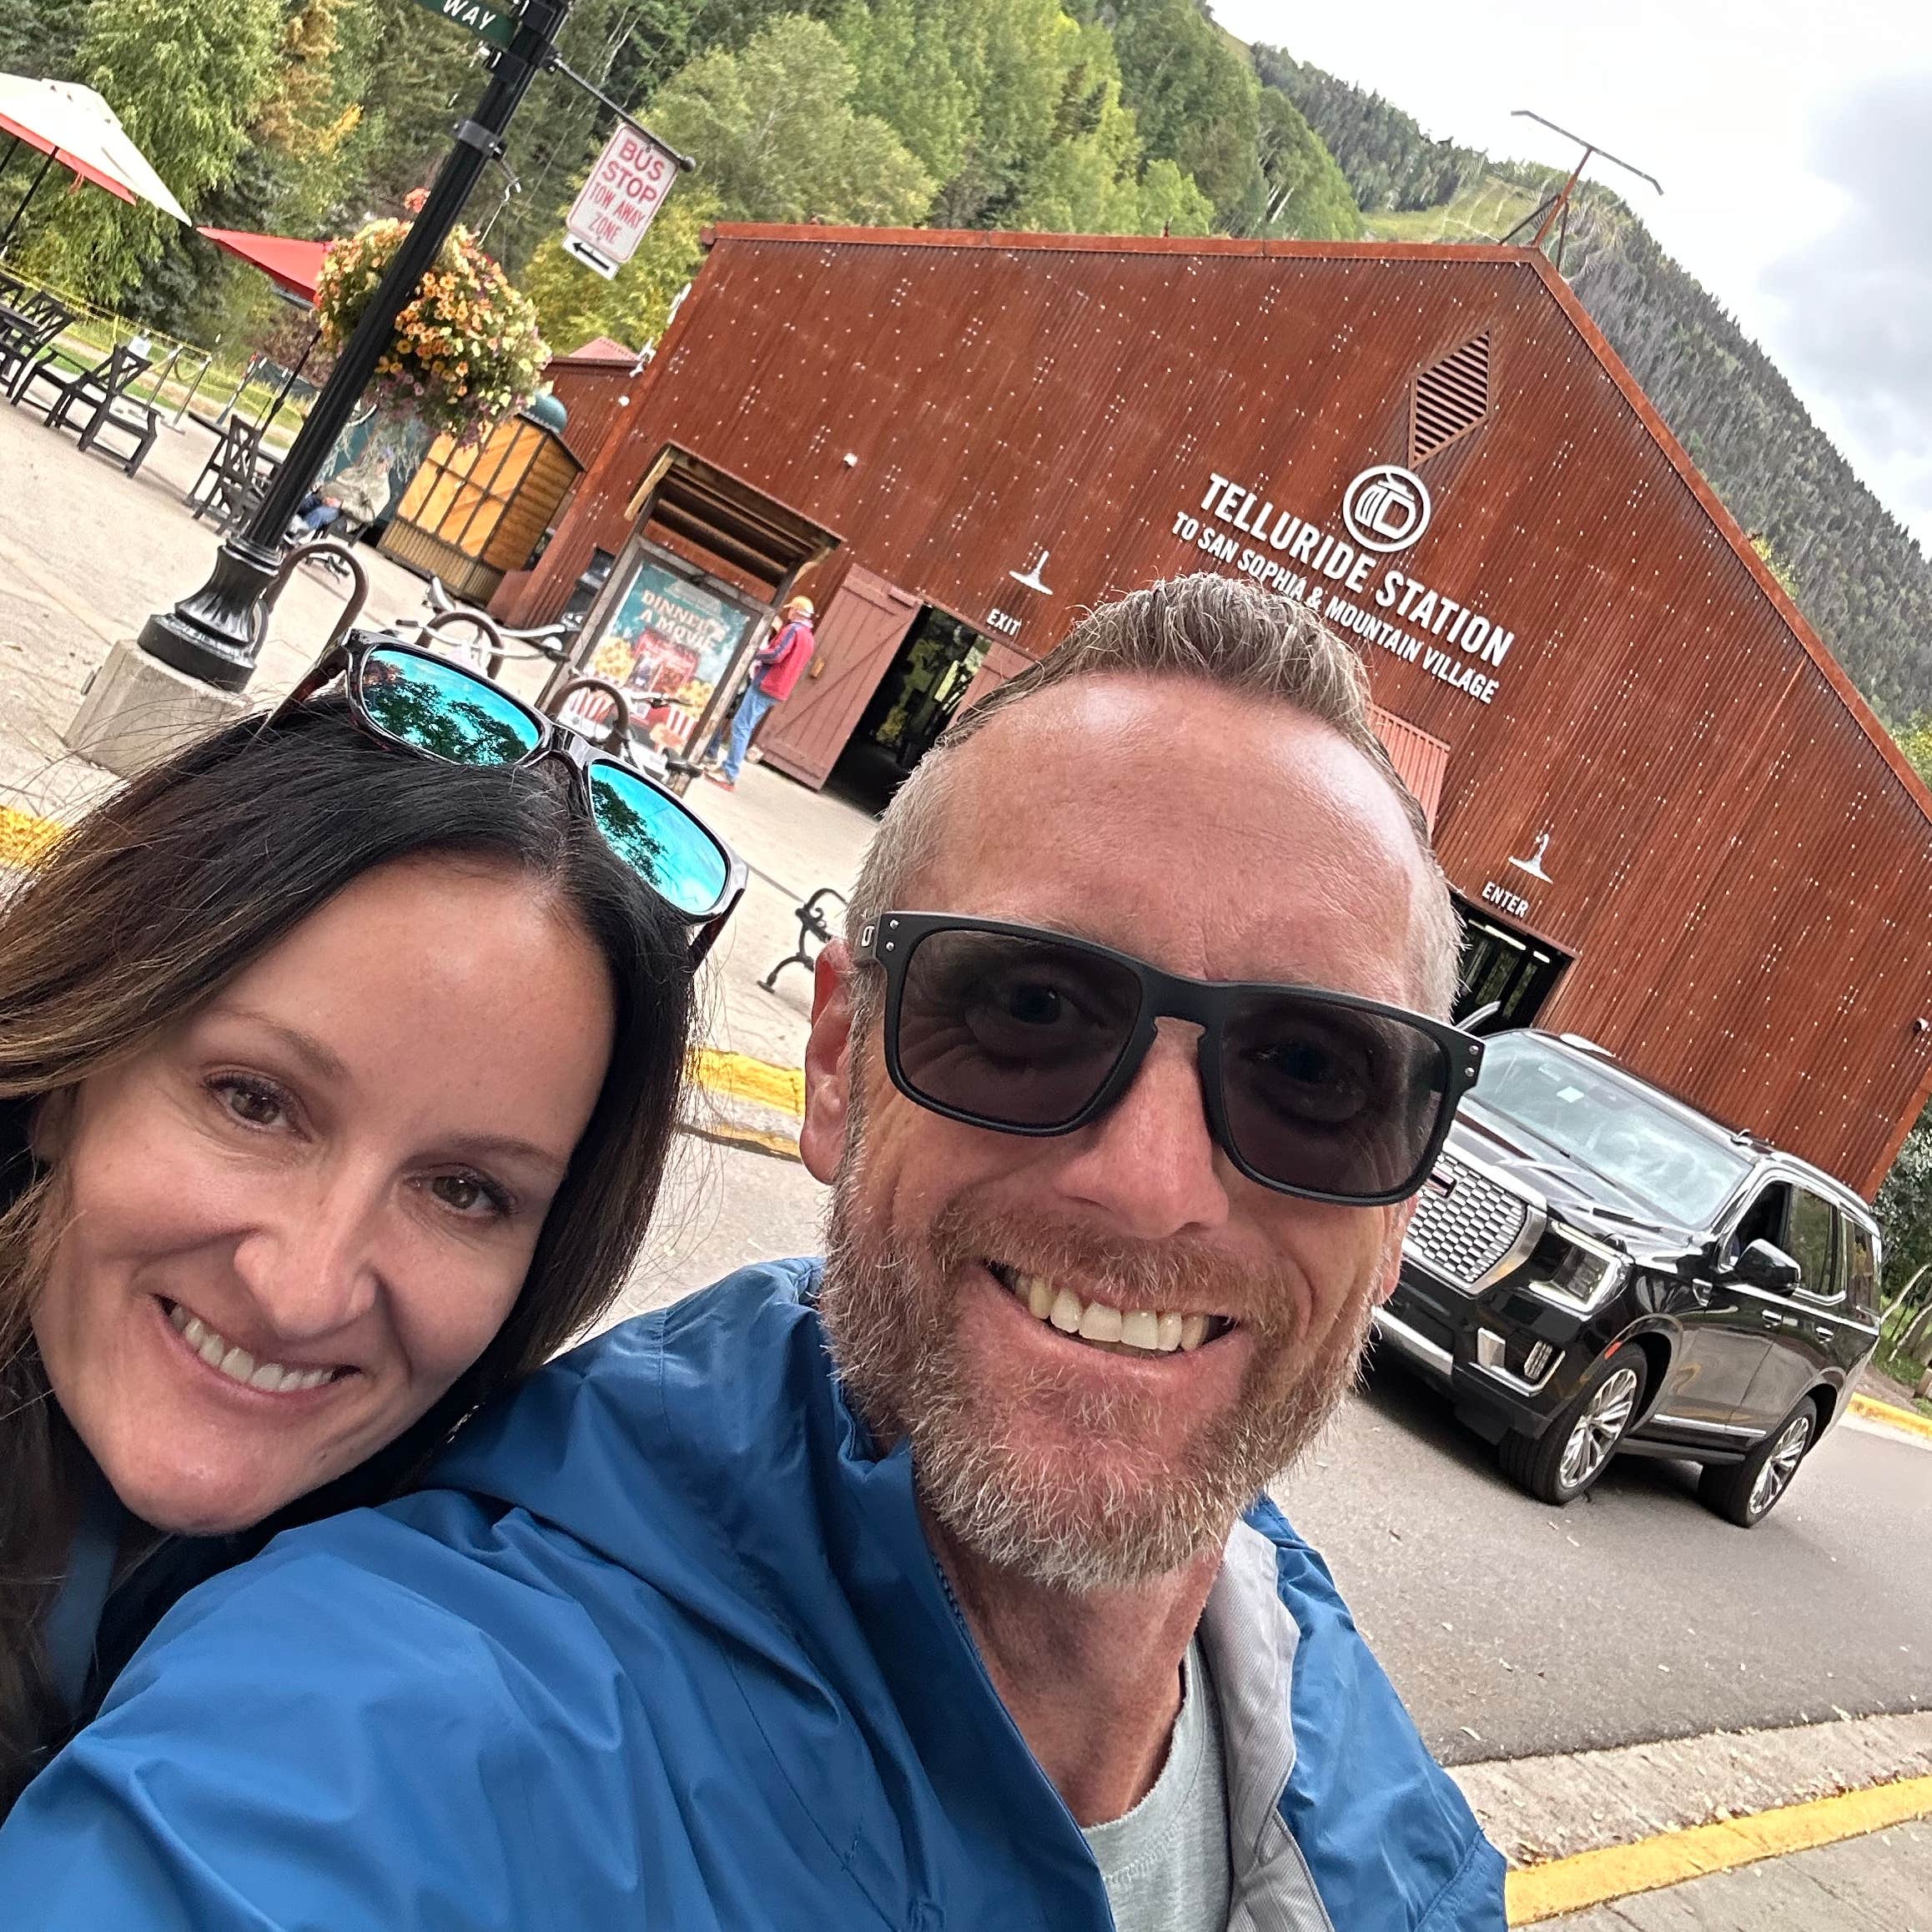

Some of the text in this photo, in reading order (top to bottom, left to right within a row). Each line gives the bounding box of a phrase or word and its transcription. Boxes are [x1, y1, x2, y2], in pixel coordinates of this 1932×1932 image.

[443, 0, 496, 31] WAY
[619, 138, 665, 181] BUS
[601, 160, 657, 204] STOP
[589, 182, 647, 229] TOW AWAY
[587, 212, 622, 244] ZONE
[1200, 472, 1515, 668] TELLURIDE STATION
[986, 607, 1022, 636] EXIT
[1172, 511, 1500, 704] TO SAN SOPHIA & MOUNTAIN VILLAGE
[1482, 881, 1529, 918] ENTER
